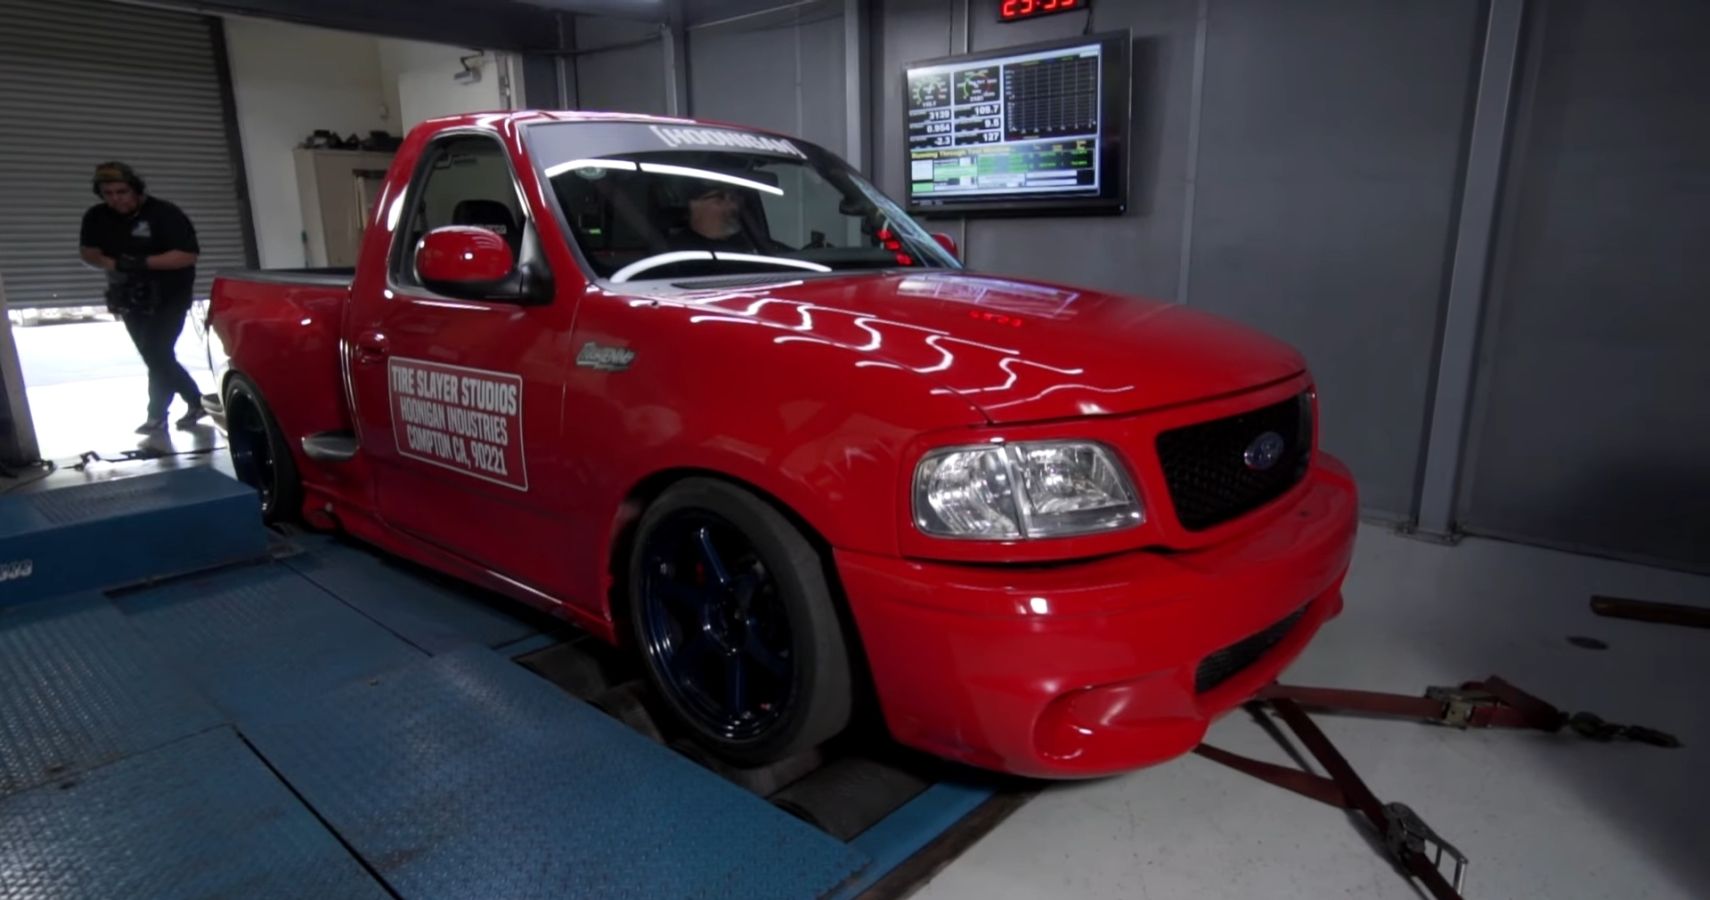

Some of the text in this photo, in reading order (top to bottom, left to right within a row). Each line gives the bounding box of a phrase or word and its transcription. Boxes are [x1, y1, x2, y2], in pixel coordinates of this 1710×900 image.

[391, 365, 517, 416] TIRE SLAYER STUDIOS
[399, 395, 508, 446] HOONIGAN INDUSTRIES
[406, 423, 508, 476] COMPTON CA, 90221
